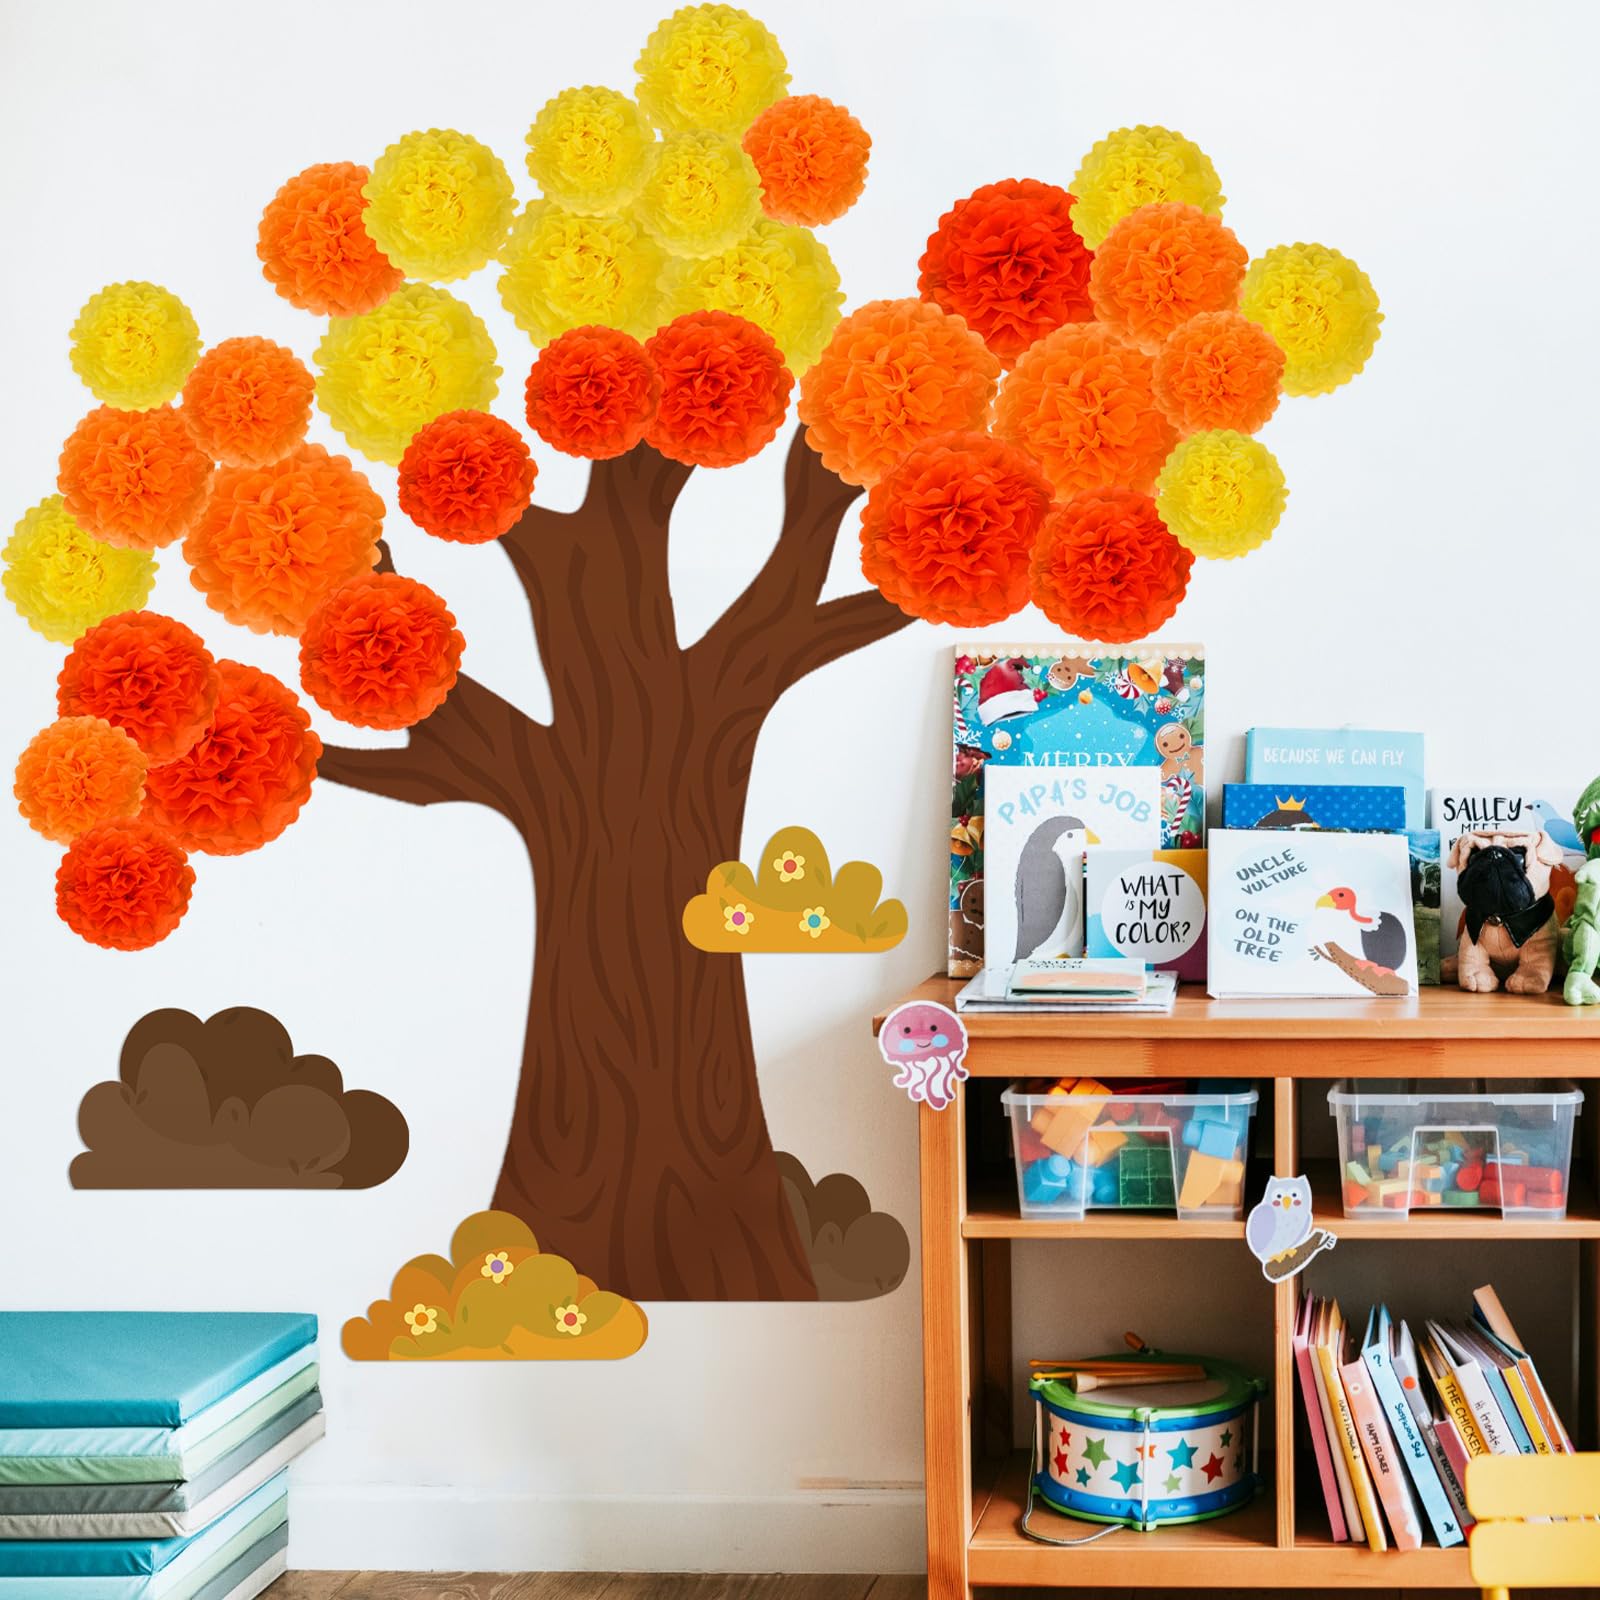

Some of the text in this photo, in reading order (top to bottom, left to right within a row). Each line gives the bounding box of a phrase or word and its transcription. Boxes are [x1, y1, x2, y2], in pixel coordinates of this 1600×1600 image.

[1022, 751, 1135, 767] MERRY
[1263, 747, 1405, 767] BECAUSE WE CAN FLY
[998, 777, 1152, 825] PAPA'S JOB
[1443, 797, 1522, 821] SALLEY
[1236, 848, 1295, 881] UNCLE
[1120, 874, 1185, 896] WHAT
[1241, 861, 1308, 895] VULTURE
[1139, 898, 1171, 920] MY
[1115, 921, 1191, 944] COLOR?
[1235, 908, 1299, 934] ON THE
[1243, 927, 1281, 946] OLD
[1233, 939, 1283, 962] TREE
[1445, 1383, 1485, 1456] THE CHICKEN
[1365, 1422, 1390, 1475] HAPPY FLOWER
